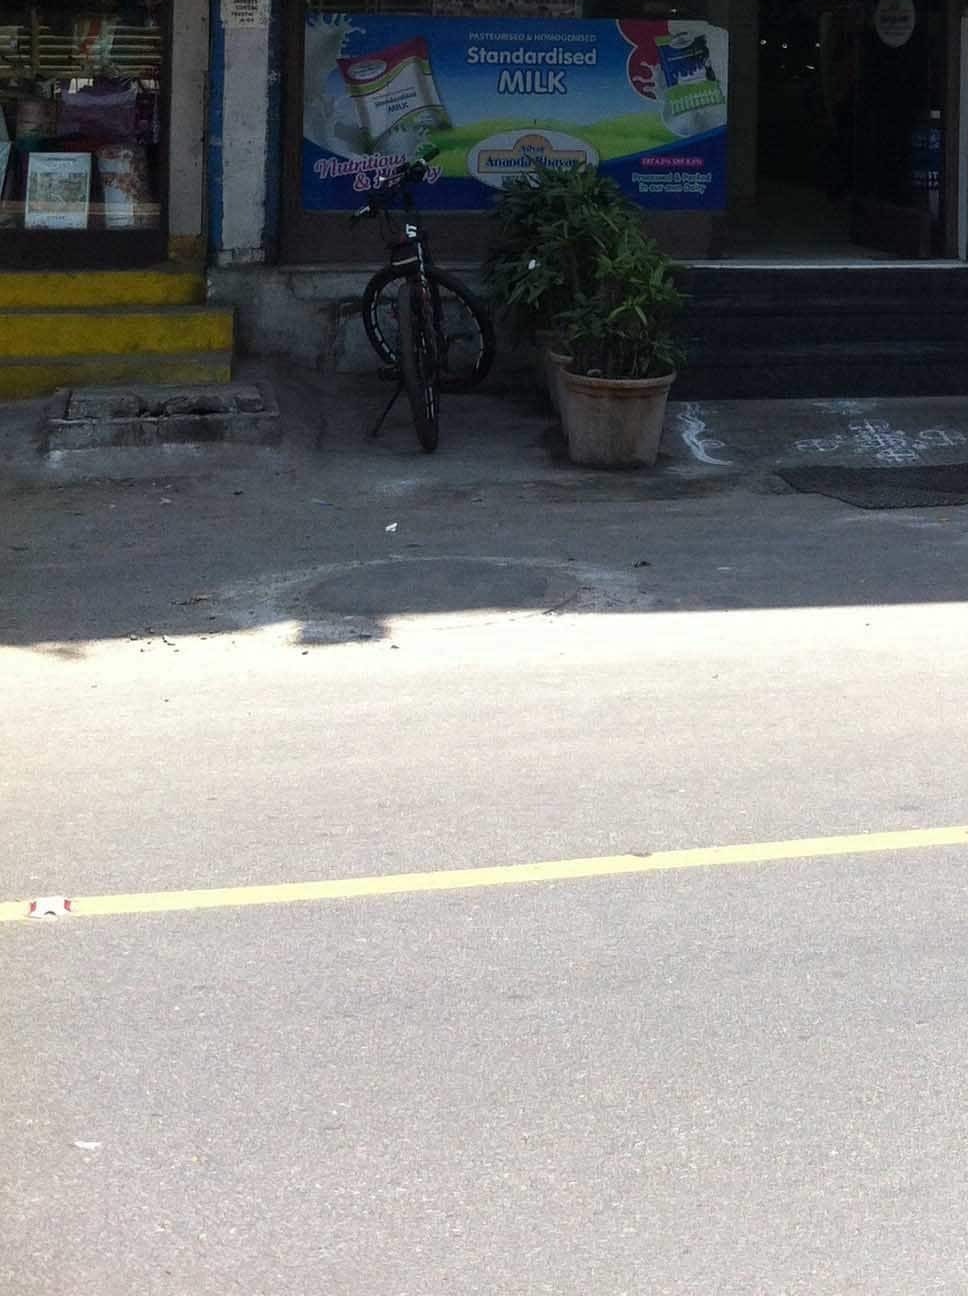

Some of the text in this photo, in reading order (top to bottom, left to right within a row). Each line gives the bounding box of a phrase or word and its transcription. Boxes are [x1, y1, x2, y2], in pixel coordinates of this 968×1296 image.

[467, 46, 597, 65] Standardised
[498, 69, 566, 94] MILK
[353, 172, 372, 191] &
